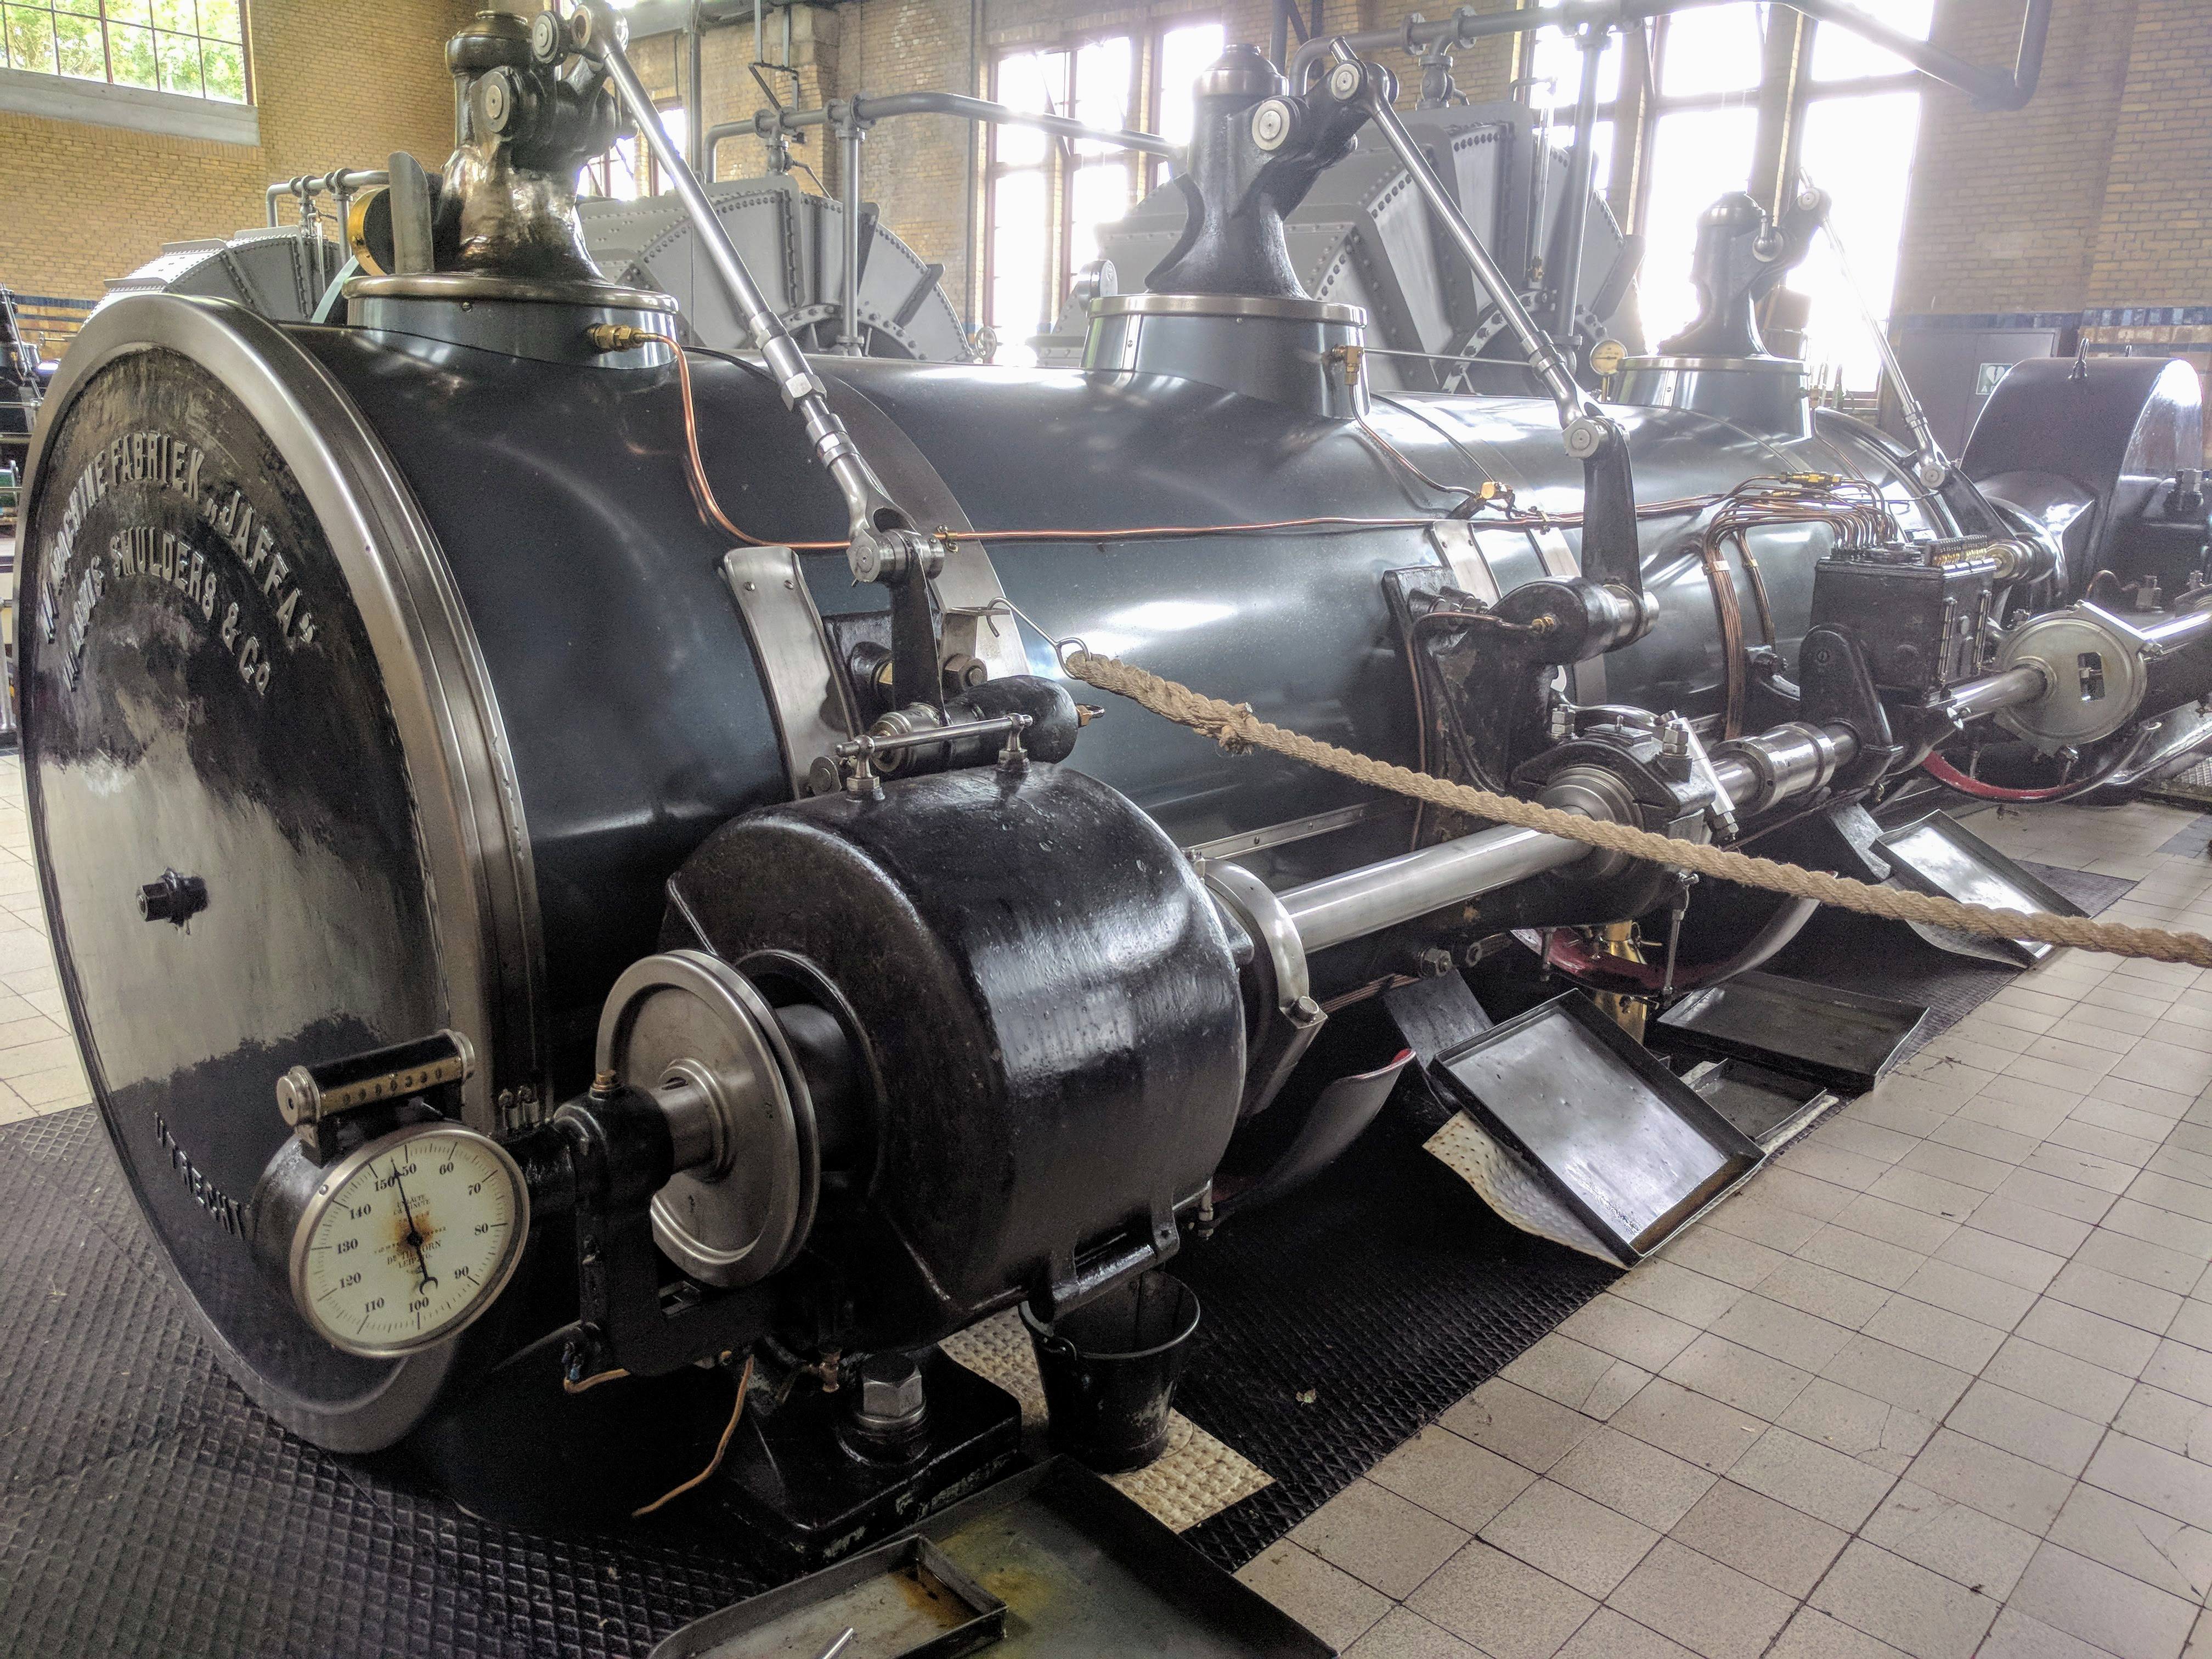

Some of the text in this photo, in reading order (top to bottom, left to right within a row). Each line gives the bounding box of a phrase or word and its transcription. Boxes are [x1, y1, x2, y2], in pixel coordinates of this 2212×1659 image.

[111, 431, 205, 502] FABRIEK
[110, 526, 217, 620] SMULDERS
[222, 602, 240, 656] &
[402, 1163, 417, 1177] 50
[439, 1161, 454, 1175] 60
[375, 1176, 396, 1192] 150
[468, 1182, 481, 1196] 70
[351, 1204, 372, 1220] 140
[474, 1222, 489, 1236] 80
[337, 1238, 358, 1254] 130
[339, 1272, 362, 1289] 120
[454, 1266, 469, 1280] 90
[364, 1297, 385, 1313] 110
[409, 1296, 430, 1313] 100
